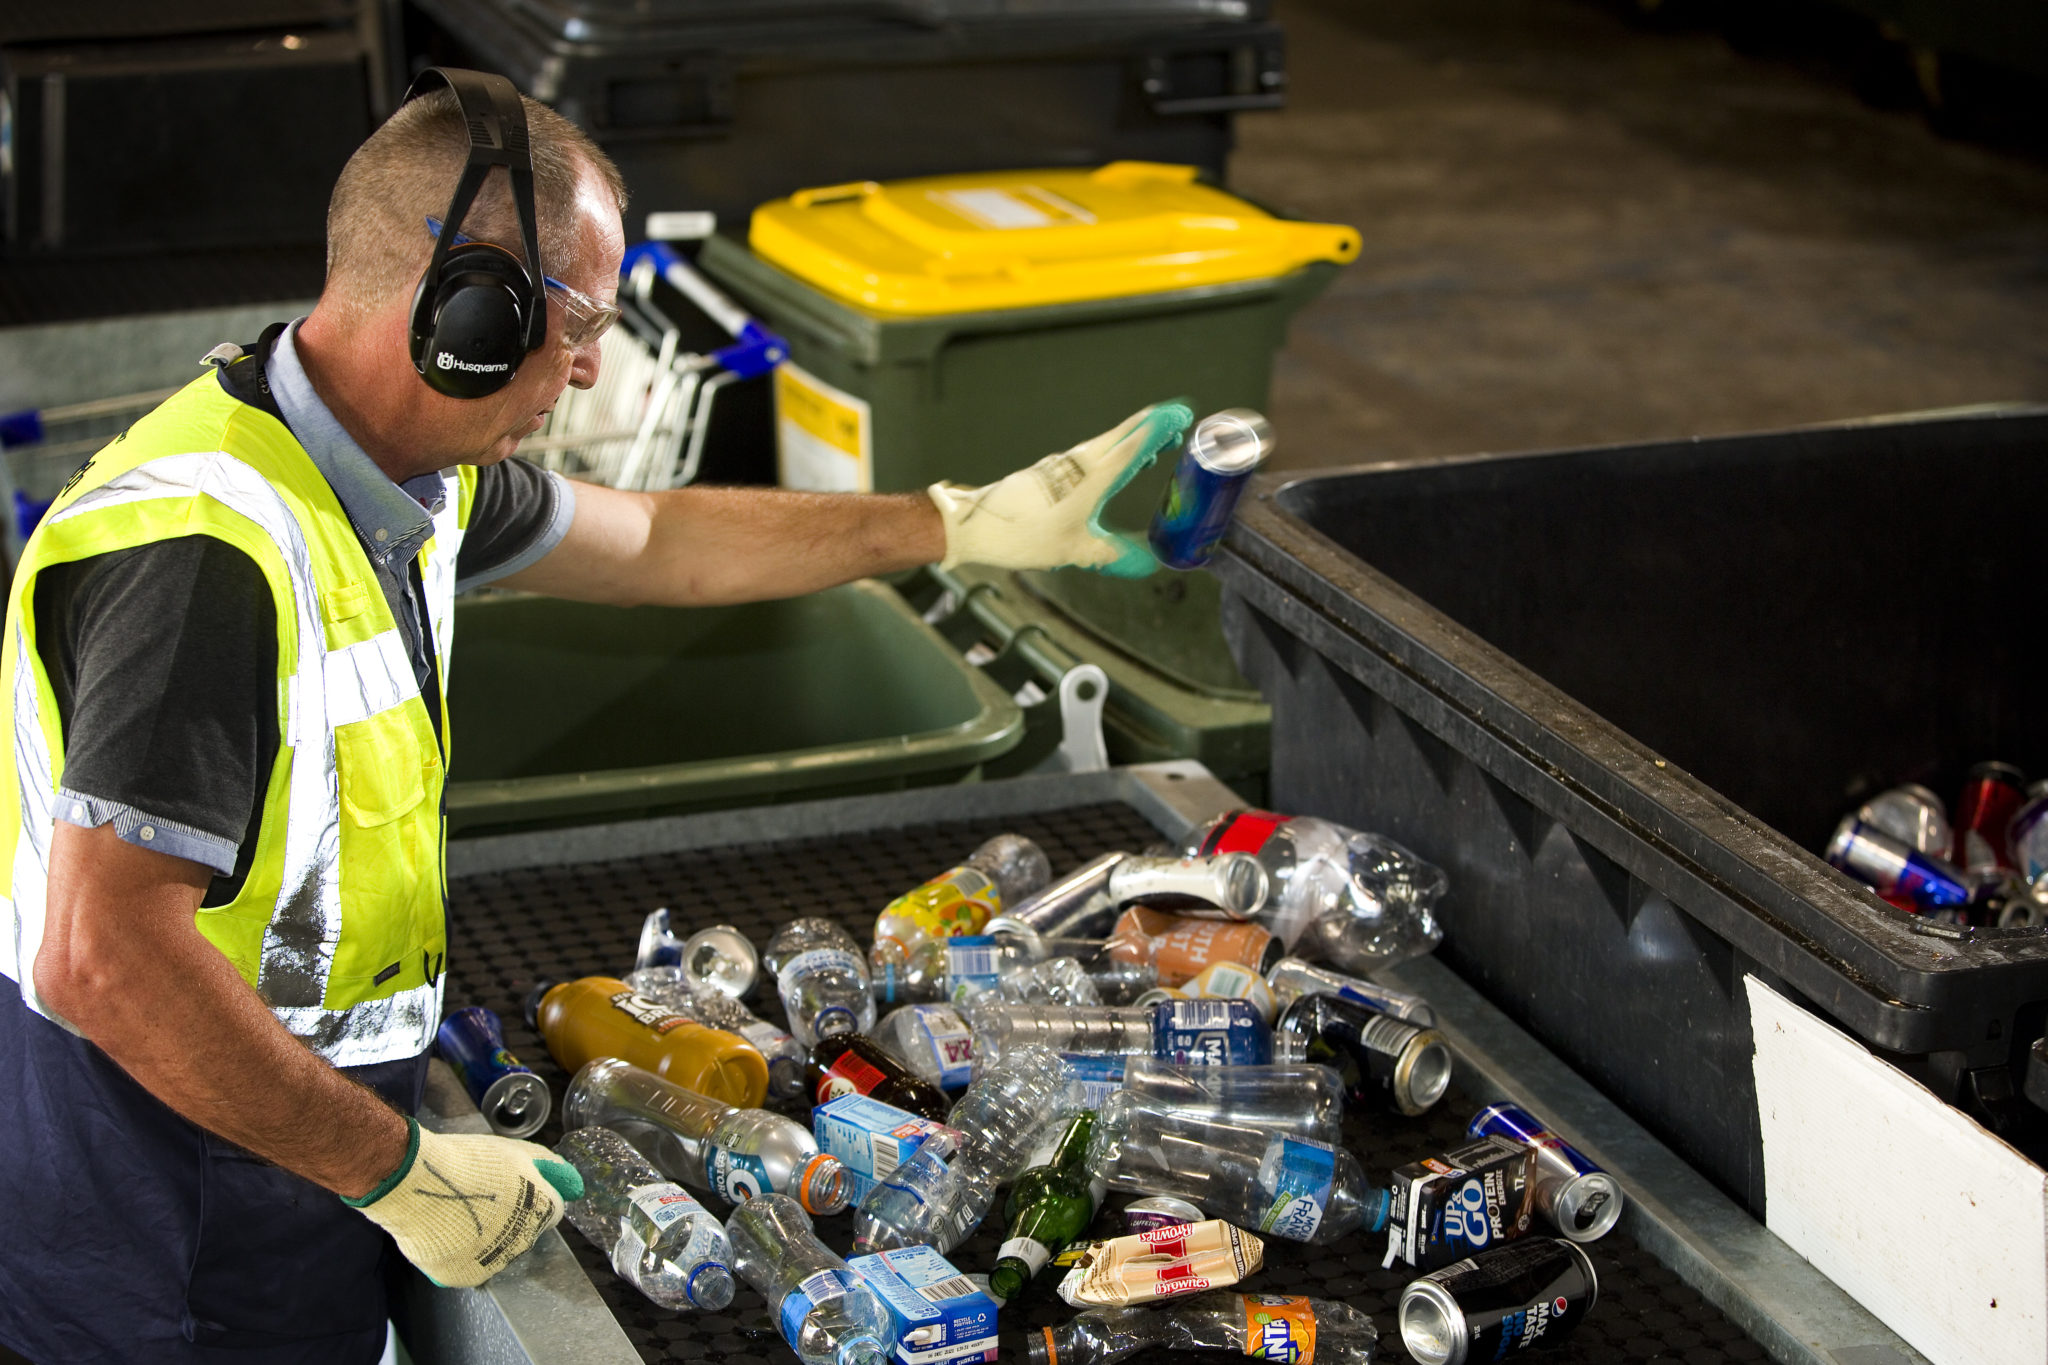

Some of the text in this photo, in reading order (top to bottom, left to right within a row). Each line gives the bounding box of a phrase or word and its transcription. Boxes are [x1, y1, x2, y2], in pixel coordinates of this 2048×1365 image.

[453, 359, 508, 374] Husqvarna
[1484, 1172, 1505, 1240] PROTEIN
[1496, 1169, 1506, 1206] ENERGIZE
[1445, 1200, 1464, 1237] UP
[1461, 1178, 1488, 1247] GO
[1155, 1277, 1210, 1295] Brownes
[1513, 1311, 1526, 1337] NO
[1519, 1305, 1537, 1349] TASTE
[1533, 1302, 1549, 1338] MAX
